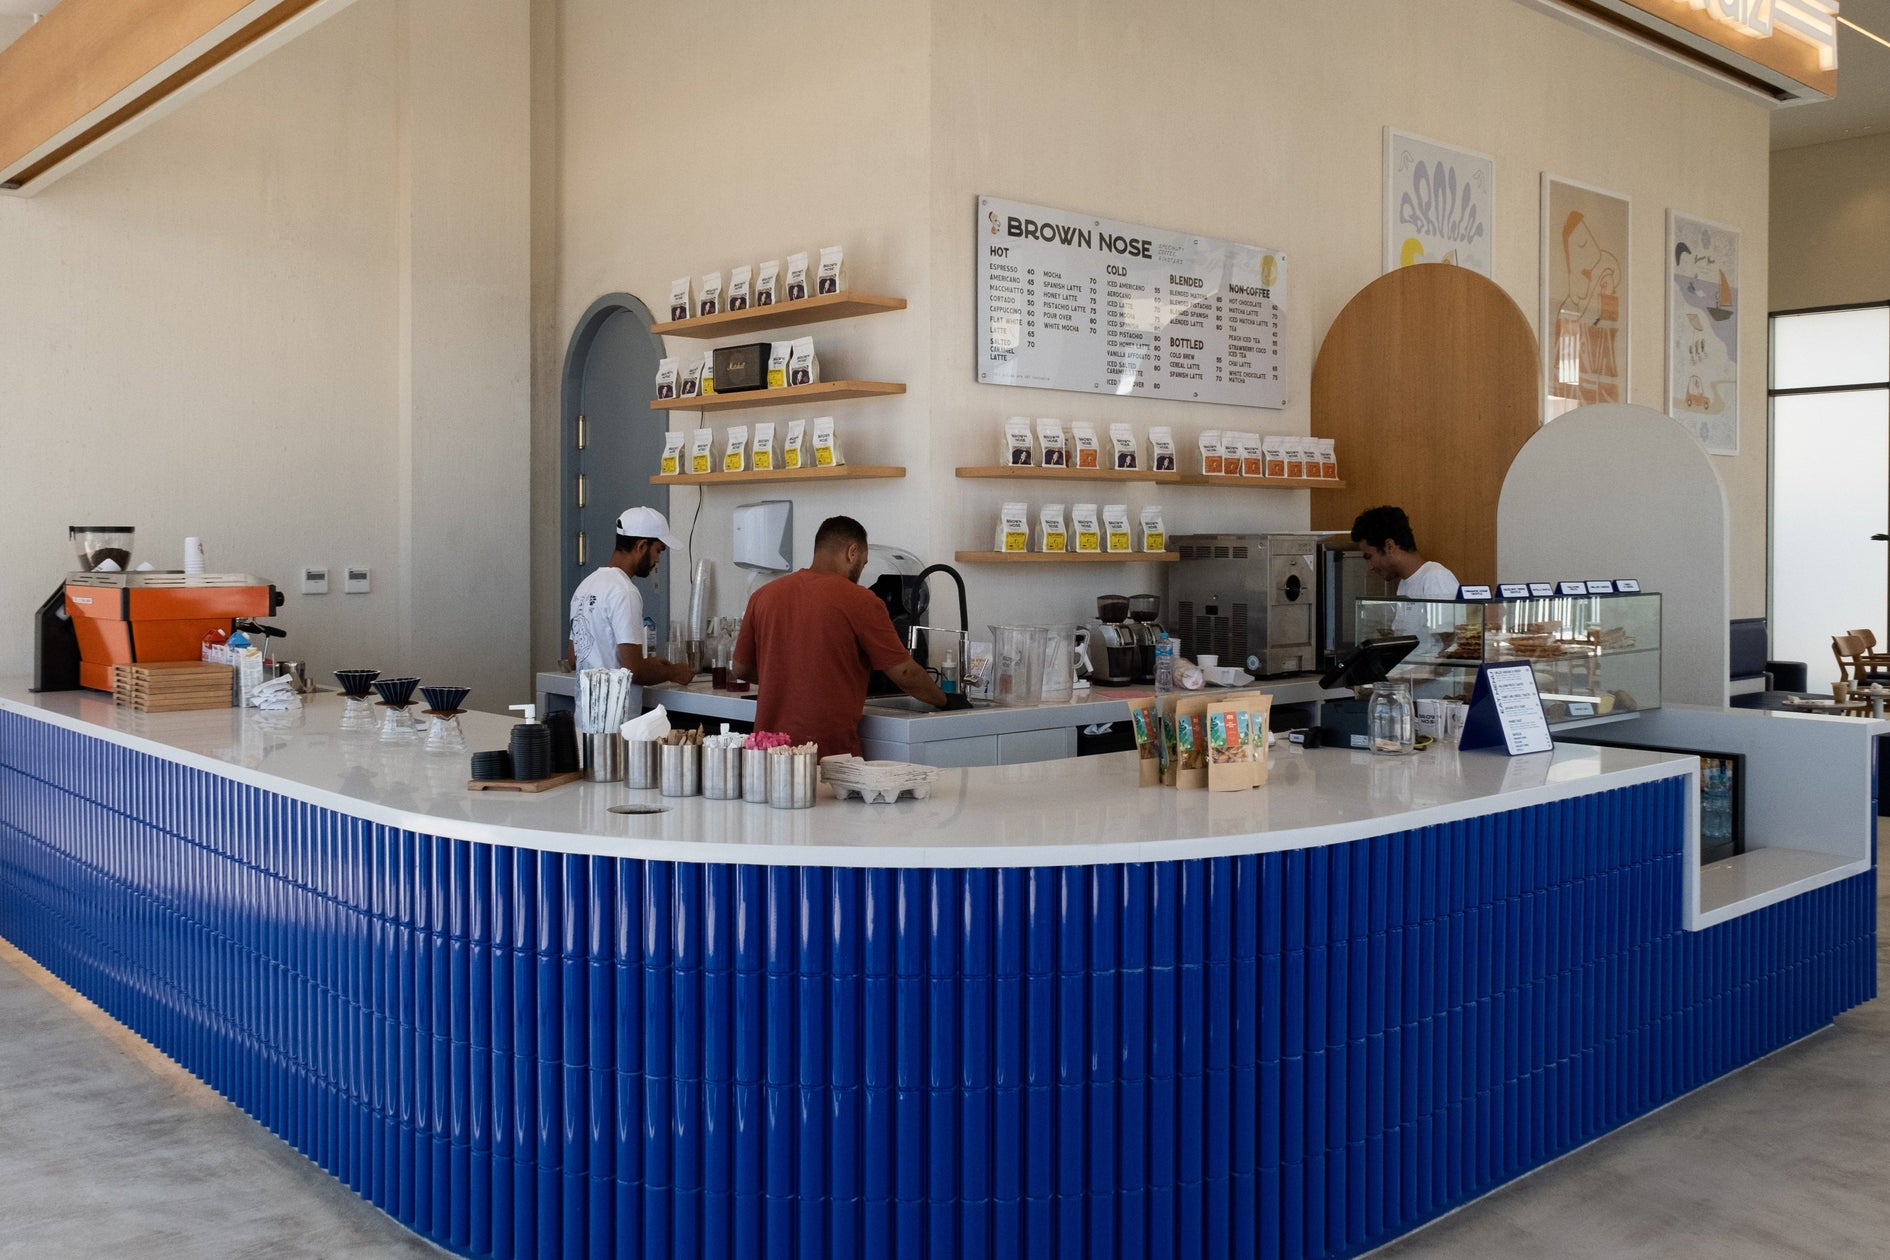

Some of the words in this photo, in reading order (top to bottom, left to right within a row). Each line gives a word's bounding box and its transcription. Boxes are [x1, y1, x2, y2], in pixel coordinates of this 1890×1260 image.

[1007, 216, 1091, 249] BROWN
[1099, 232, 1152, 259] NOSE
[990, 246, 1009, 258] HOT
[990, 263, 1018, 272] ESPRESSO
[1106, 264, 1127, 276] COLD
[990, 274, 1020, 284] AMERICANO
[1044, 270, 1062, 279] MOCHA
[1170, 274, 1203, 288] BLENDED
[990, 284, 1024, 294] MACCHIATTO
[1044, 281, 1065, 290] SPANISH
[1066, 284, 1082, 292] LATTE
[1119, 282, 1145, 292] AMERICANO
[1229, 283, 1270, 299] NON-COFFEE
[1044, 292, 1060, 300] HONEY
[1107, 290, 1132, 300] AEROCANO
[1170, 290, 1189, 298] BLENDED
[990, 295, 1015, 304] CORTADO
[1239, 300, 1262, 308] CHOCOLATE
[990, 306, 1022, 315] CAPPUCCINO
[1044, 302, 1070, 311] PISTACHIO
[1071, 305, 1086, 313] LATTE
[1190, 302, 1212, 310] STACHIO
[1005, 318, 1022, 326] WHITE
[990, 326, 1007, 334] LATTE
[1044, 322, 1060, 330] WHITE
[1062, 324, 1079, 332] MOCHA
[1119, 332, 1144, 340] PISTACHIO
[990, 338, 1011, 346] SALTED
[1170, 337, 1204, 350] BOTTLED
[1229, 344, 1254, 352] STRAWBERRY
[1243, 372, 1266, 380] CHOCOLATE
